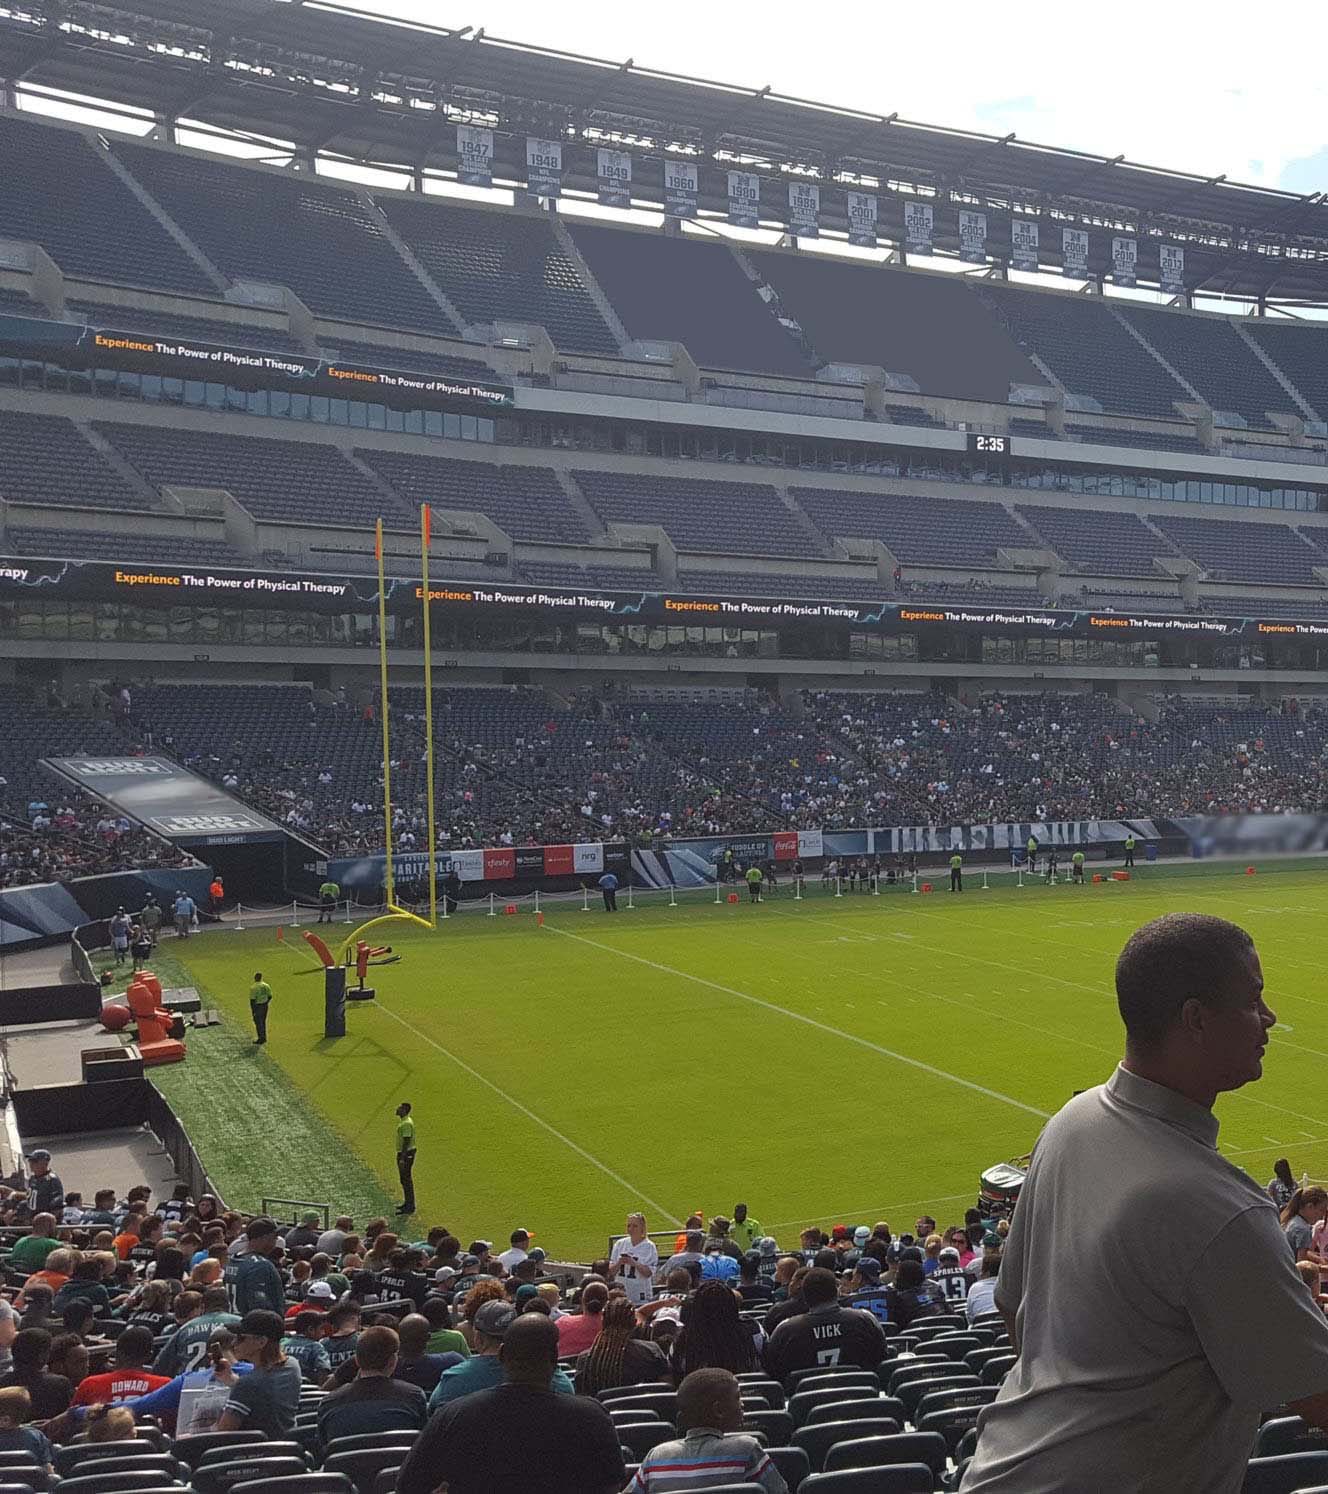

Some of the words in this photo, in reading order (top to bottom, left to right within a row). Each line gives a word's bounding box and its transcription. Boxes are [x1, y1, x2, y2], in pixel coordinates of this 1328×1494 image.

[462, 141, 489, 155] 1947
[531, 154, 558, 168] 1948
[602, 165, 628, 179] 1949
[669, 176, 694, 189] 1960
[95, 336, 153, 351] Experience
[154, 343, 175, 354] The
[177, 347, 208, 358] Power
[210, 352, 221, 360] of
[223, 353, 262, 366] Physical
[264, 358, 304, 373] Therapy
[327, 368, 377, 381] Experience
[378, 375, 396, 384] The
[397, 378, 424, 388] Power
[436, 383, 470, 394] Physical
[471, 388, 505, 400] Therapy
[977, 436, 1004, 452] 2:35
[115, 572, 179, 584] Experience
[181, 576, 204, 586] The
[207, 577, 241, 587] Power
[243, 579, 254, 588] of
[257, 579, 300, 591] Physical
[302, 582, 345, 595] Therapy
[415, 587, 471, 601] Eperience
[473, 591, 492, 601] The
[494, 593, 524, 602] Power
[526, 595, 536, 603] of
[538, 595, 576, 606] Physical
[577, 597, 615, 609] Therapy
[664, 600, 718, 610] Experience
[720, 602, 739, 611] The
[741, 603, 769, 612] Power
[772, 605, 781, 613] of
[783, 605, 820, 615] Physical
[821, 606, 859, 619] Therapy
[900, 611, 943, 619] Experience
[961, 613, 984, 621] Power
[994, 615, 1024, 623] Physical
[1025, 616, 1055, 625] Therapy
[1090, 618, 1128, 626] Experience
[1173, 621, 1199, 629] Physical
[1200, 622, 1226, 631] Therapy
[1258, 624, 1294, 632] Experience
[813, 1323, 842, 1339] VICK
[817, 1348, 841, 1367] 7
